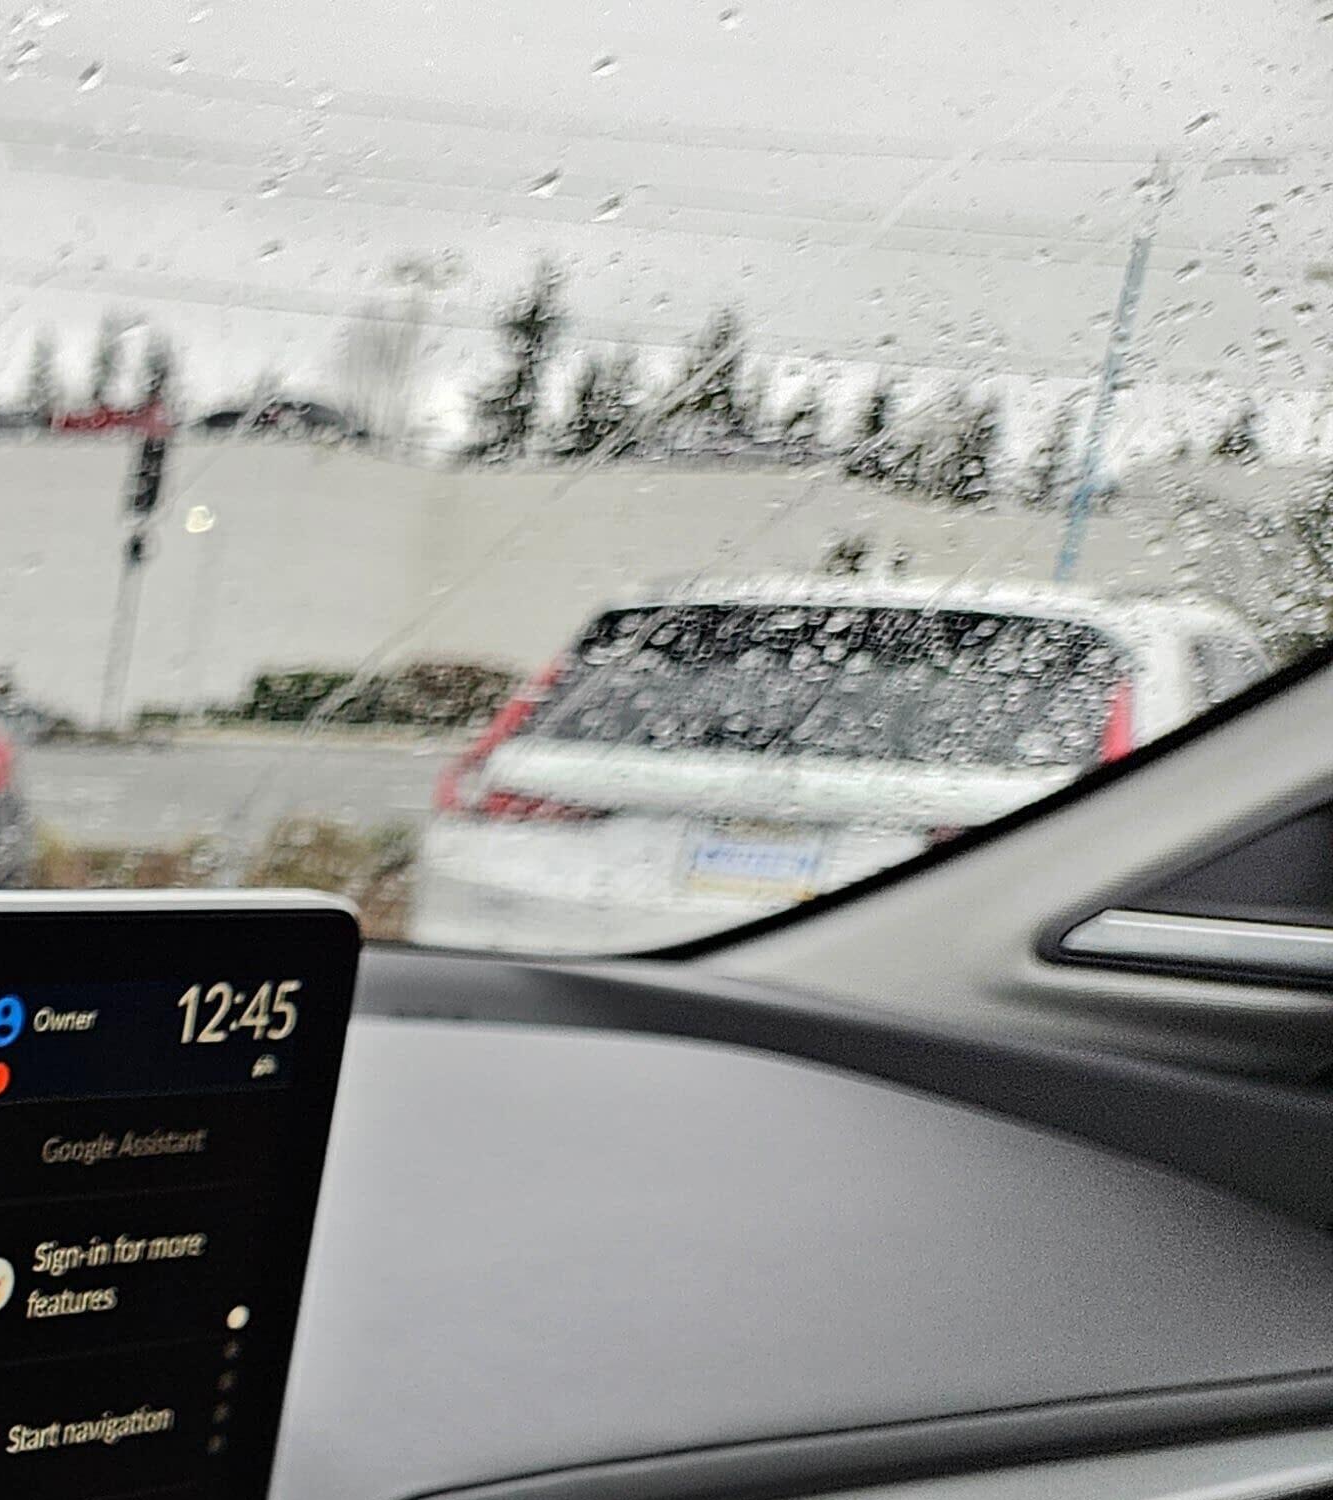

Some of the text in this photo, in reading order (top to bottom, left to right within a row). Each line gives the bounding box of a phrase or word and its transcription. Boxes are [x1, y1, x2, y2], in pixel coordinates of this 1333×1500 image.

[33, 1007, 97, 1032] Owner
[177, 980, 301, 1044] 12:45
[41, 1129, 207, 1166] Google Assistant
[32, 1234, 204, 1277] Sign-in for more
[26, 1287, 116, 1319] features
[5, 1406, 172, 1454] Start navigation
